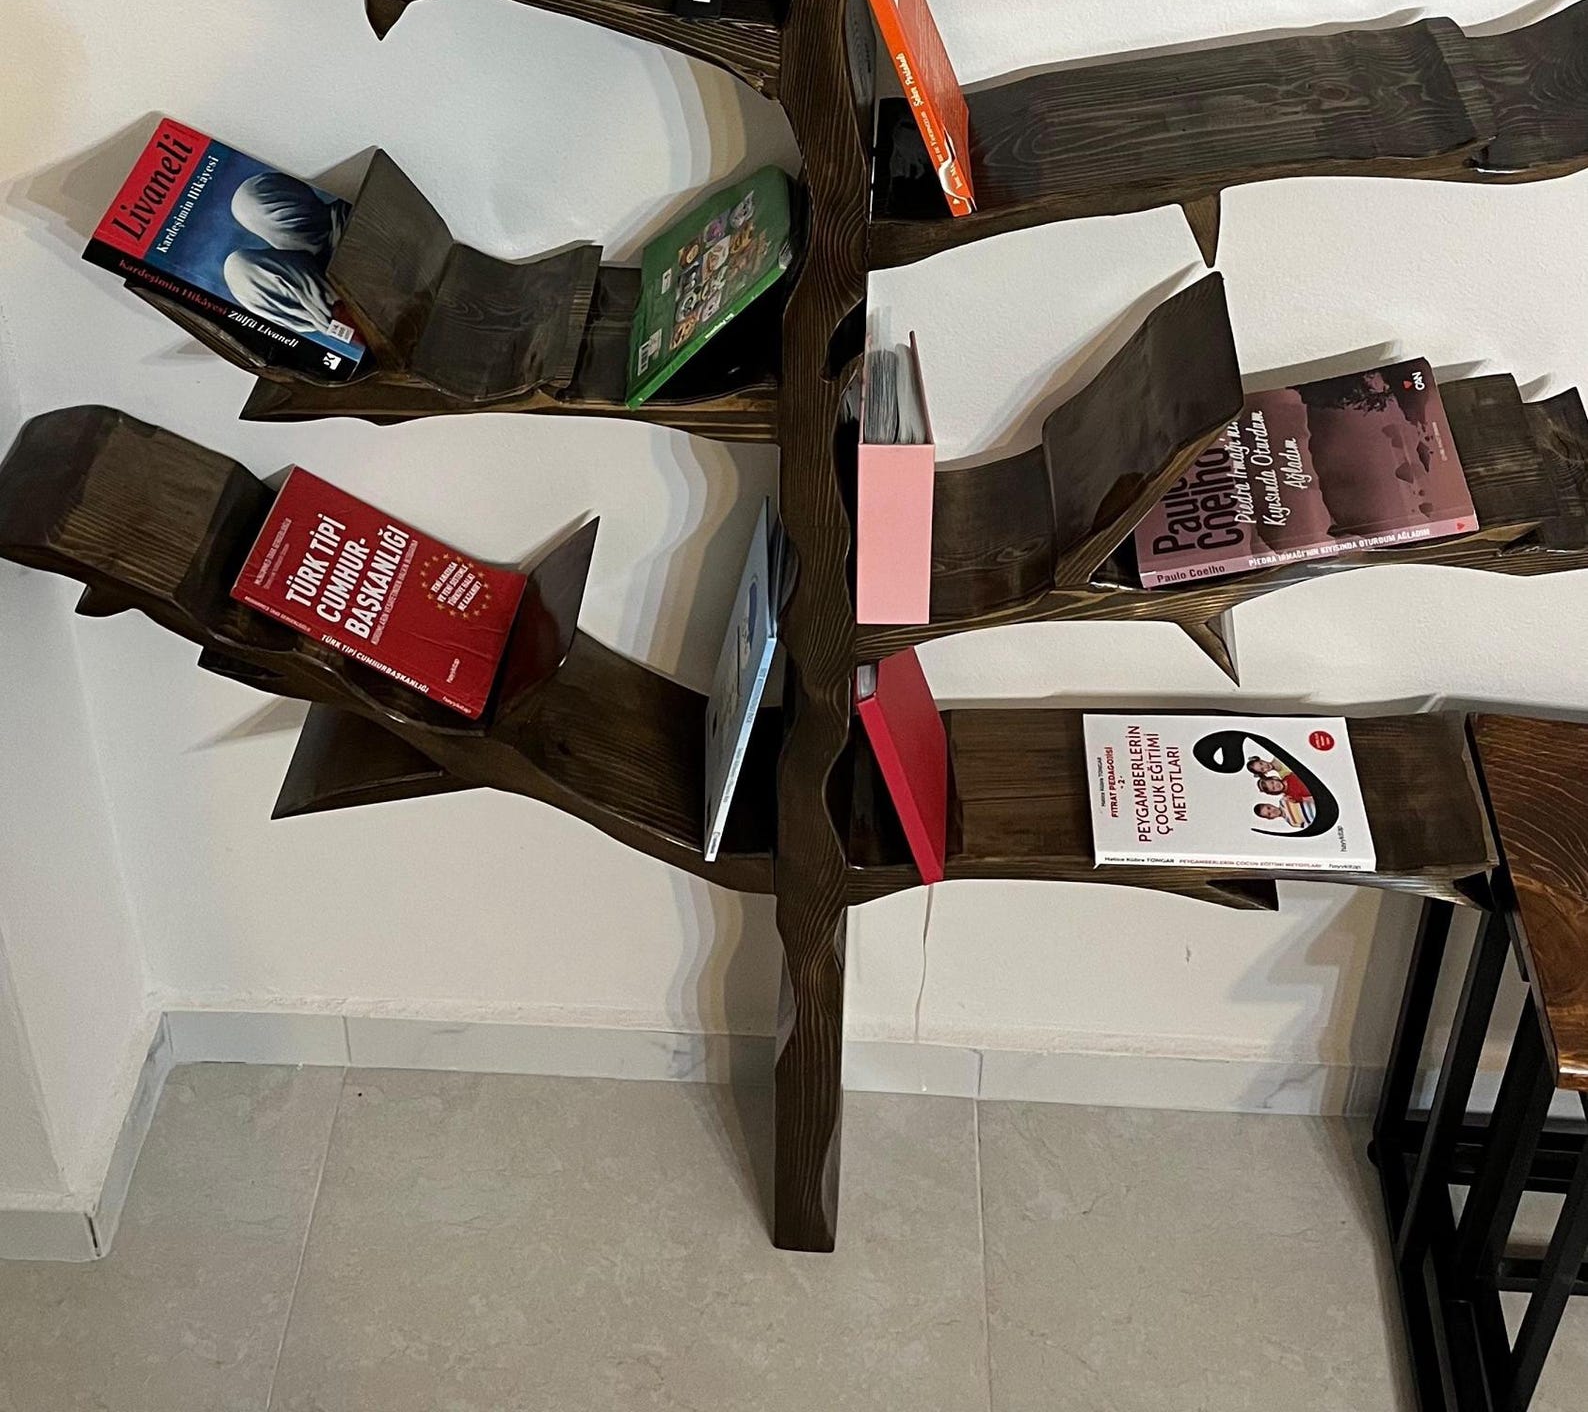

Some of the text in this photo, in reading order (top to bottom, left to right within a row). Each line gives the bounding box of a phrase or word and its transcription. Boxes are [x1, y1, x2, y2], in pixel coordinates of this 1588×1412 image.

[111, 133, 193, 241] Livaneli
[156, 201, 194, 253] Kardeşimin
[119, 259, 180, 293] Kardeşimin
[227, 310, 258, 329] Zülfü
[257, 324, 299, 348] Livaneli
[1411, 371, 1426, 391] CAN
[1230, 482, 1257, 524] Piedra
[1245, 410, 1291, 526] Kıyısında Oturdum
[1279, 438, 1312, 489] Ağladım
[285, 513, 347, 607] TÜRK TİPİ
[316, 537, 371, 623] CUMHUR-
[344, 524, 410, 639] BAŞKANLIĞI
[1156, 572, 1187, 584] Paulo
[1189, 564, 1225, 579] Coelho
[321, 634, 430, 693] TÜRK TİPİ CUMHURBAŞKANLIĞI
[1109, 792, 1119, 818] FITRAT
[1125, 725, 1152, 842] PEYGAMBERLERİN
[1144, 733, 1174, 835] ÇOCUK EĞİTİMİ
[1165, 746, 1188, 822] METOTLARI
